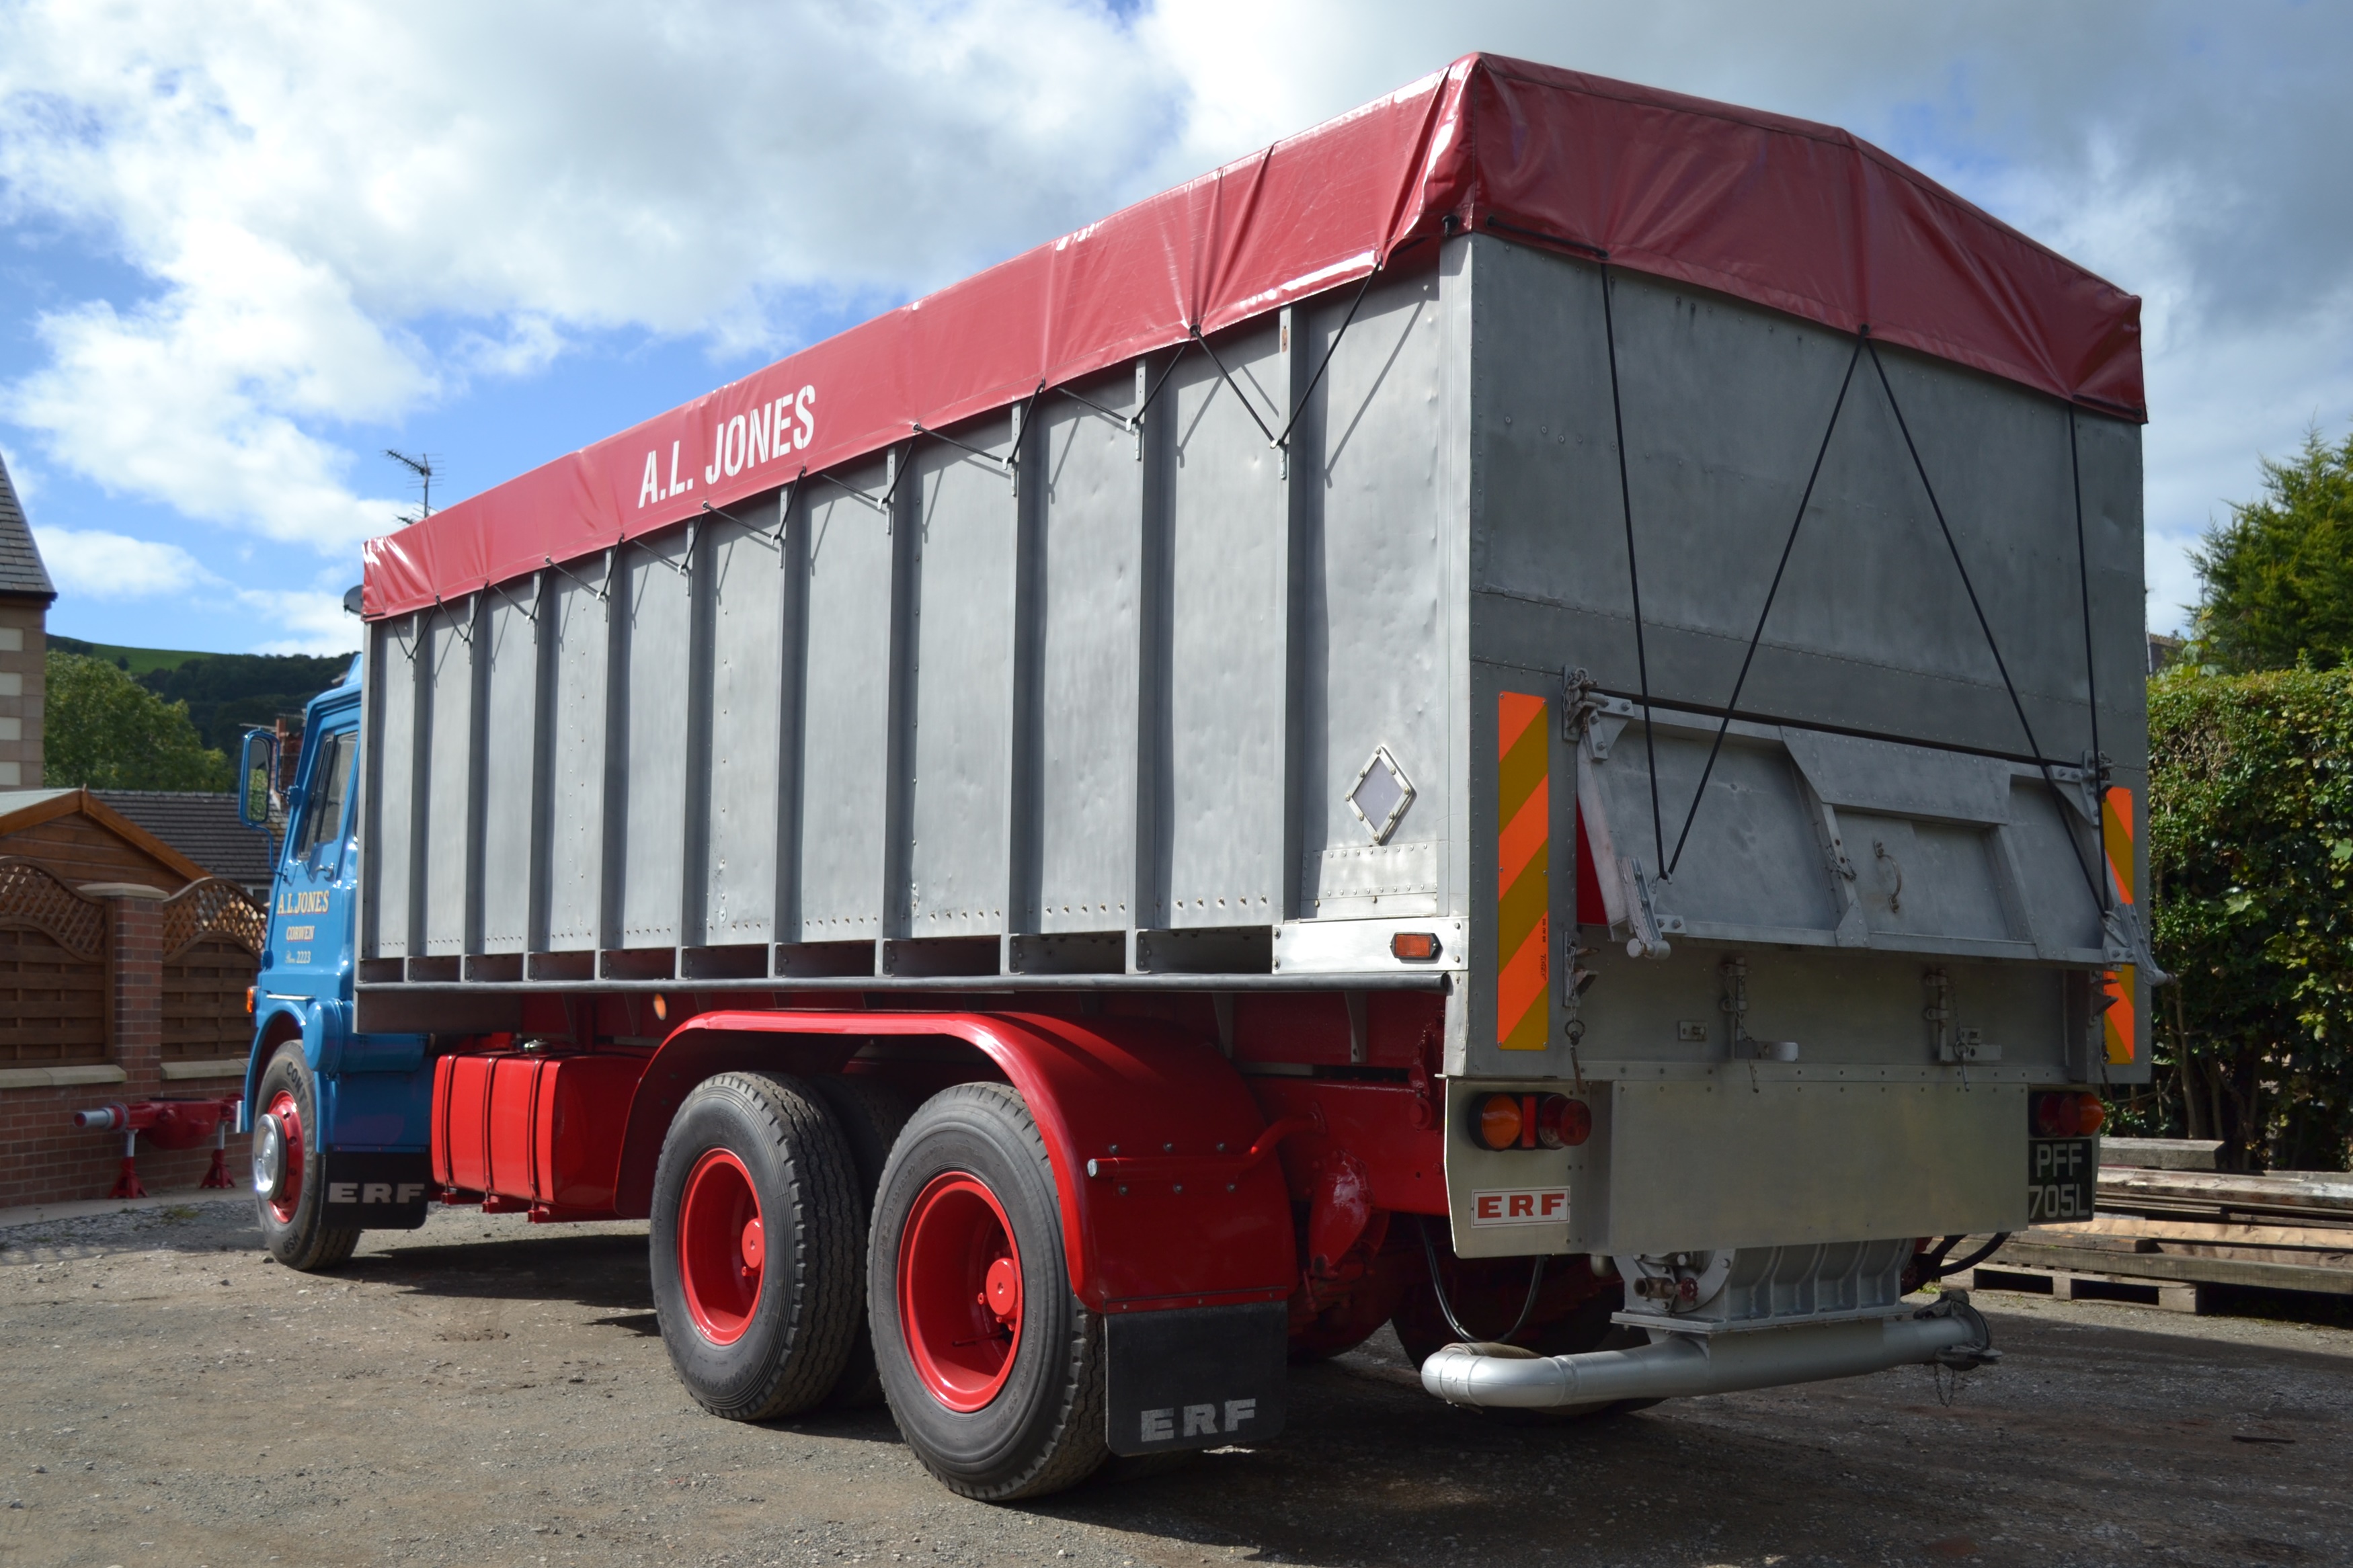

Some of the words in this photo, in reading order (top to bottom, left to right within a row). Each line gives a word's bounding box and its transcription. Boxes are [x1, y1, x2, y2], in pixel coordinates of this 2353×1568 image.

[638, 440, 694, 509] A.L.
[705, 384, 815, 485] JONES
[286, 926, 315, 941] CORWEN
[296, 951, 311, 964] 2223
[2036, 1143, 2082, 1178] PFF
[328, 1182, 425, 1203] ERF
[1478, 1193, 1565, 1219] ERF
[2028, 1184, 2089, 1219] 705L
[1141, 1398, 1256, 1442] ERF
